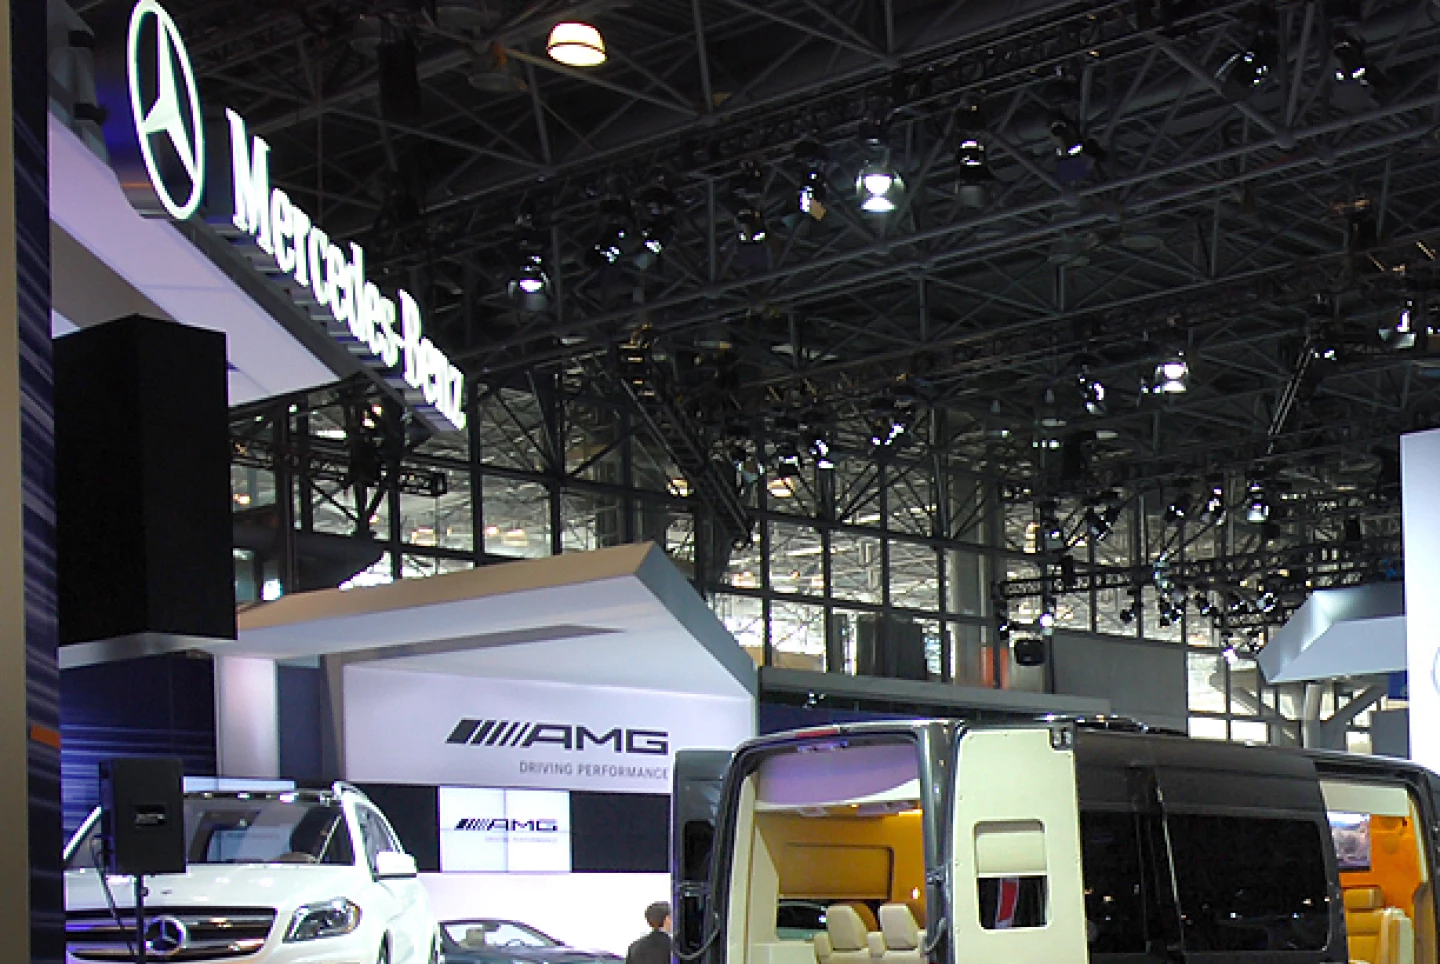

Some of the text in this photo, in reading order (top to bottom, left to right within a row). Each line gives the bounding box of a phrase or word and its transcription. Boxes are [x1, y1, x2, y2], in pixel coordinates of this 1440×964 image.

[225, 106, 467, 431] Mercedes-Benz
[519, 723, 669, 756] AMG
[519, 761, 669, 780] DRIVING PERFORMANCE
